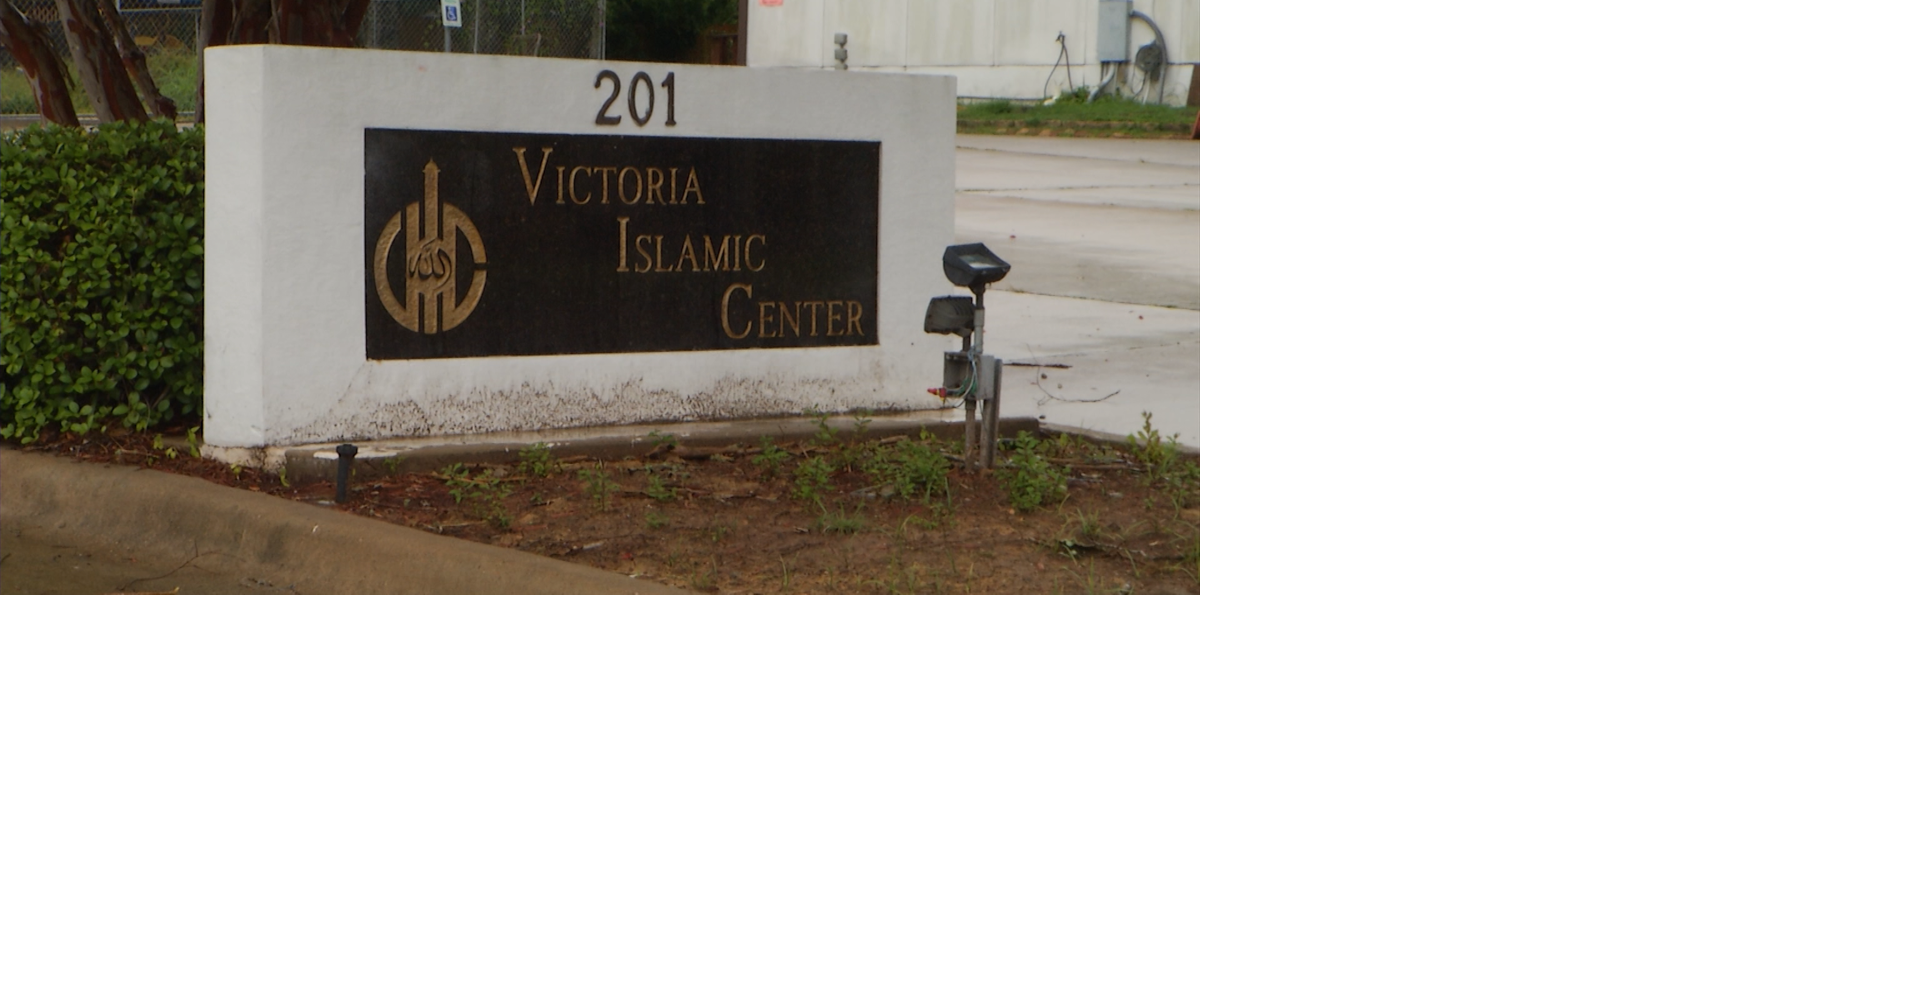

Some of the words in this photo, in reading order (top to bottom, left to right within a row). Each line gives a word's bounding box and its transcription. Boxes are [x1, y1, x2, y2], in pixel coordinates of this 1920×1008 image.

[594, 69, 677, 126] 201
[513, 146, 706, 205] VICTORIA
[616, 215, 767, 273] ISLAMIC
[720, 283, 865, 340] CENTER
